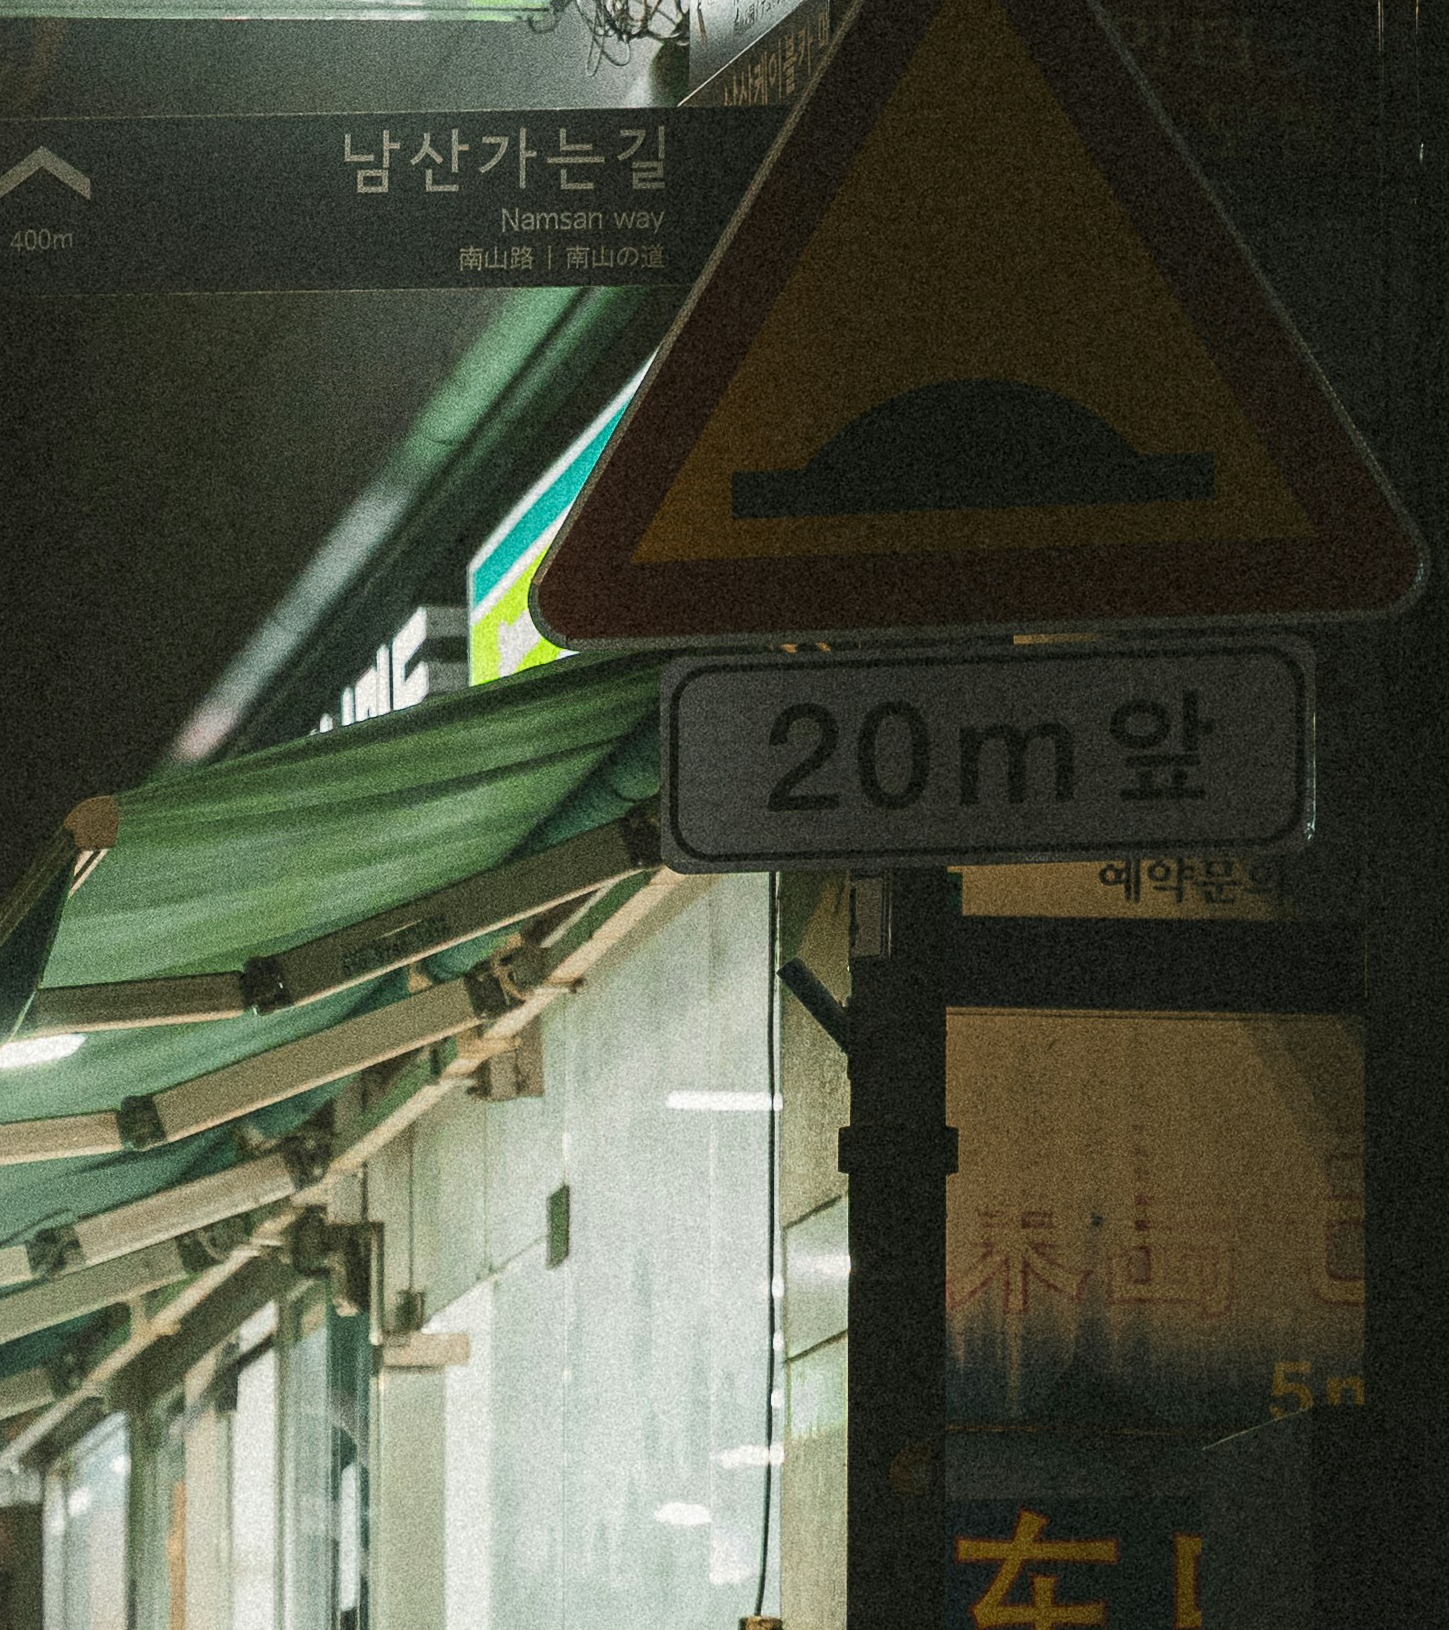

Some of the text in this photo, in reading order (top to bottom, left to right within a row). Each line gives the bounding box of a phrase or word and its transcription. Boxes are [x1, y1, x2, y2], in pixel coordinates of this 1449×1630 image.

[344, 125, 666, 194] 남산가는길
[502, 206, 666, 235] Namsan way
[9, 228, 74, 254] 400m
[458, 243, 666, 272] 南山路 南山の道
[767, 688, 1210, 813] 20m 앞
[1099, 856, 1287, 904] 예약문의
